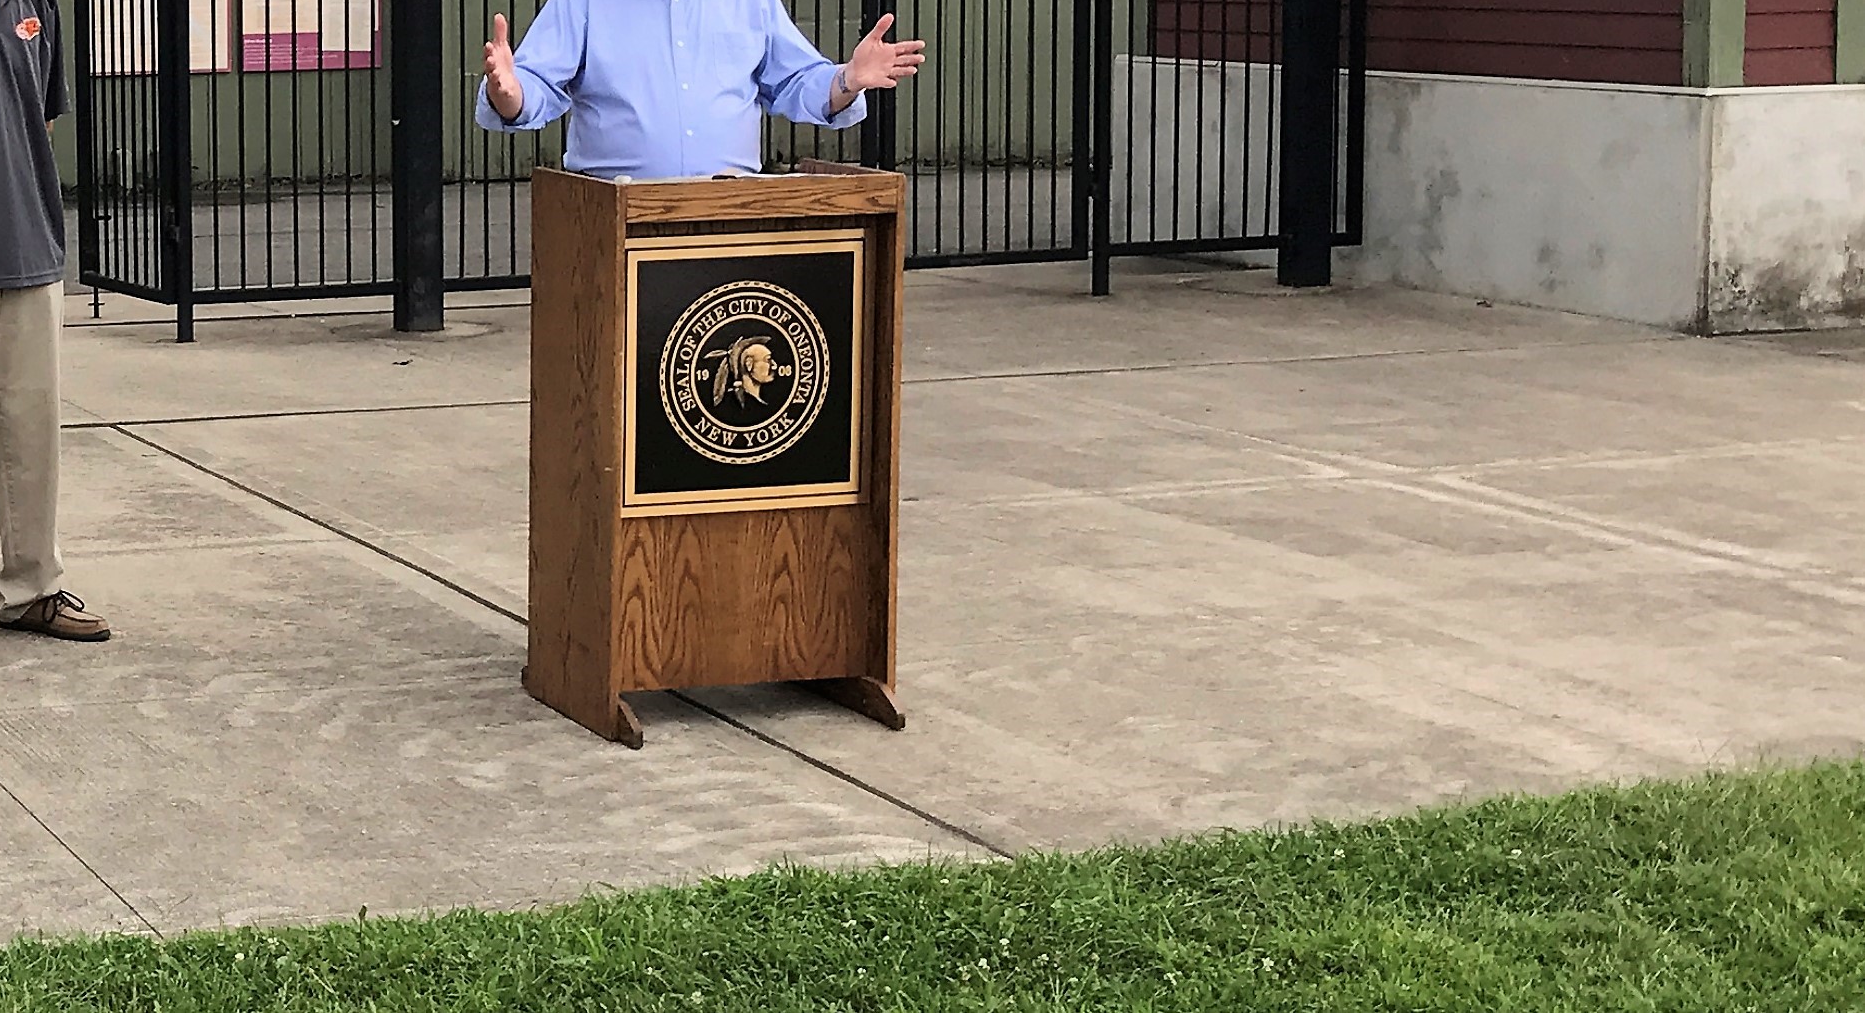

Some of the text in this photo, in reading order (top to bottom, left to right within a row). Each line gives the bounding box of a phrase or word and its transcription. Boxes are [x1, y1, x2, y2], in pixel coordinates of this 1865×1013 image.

[676, 298, 814, 413] SEAL OF THE CITY OF ONEONTA
[695, 369, 710, 381] 19
[694, 412, 796, 448] NEW YORK
